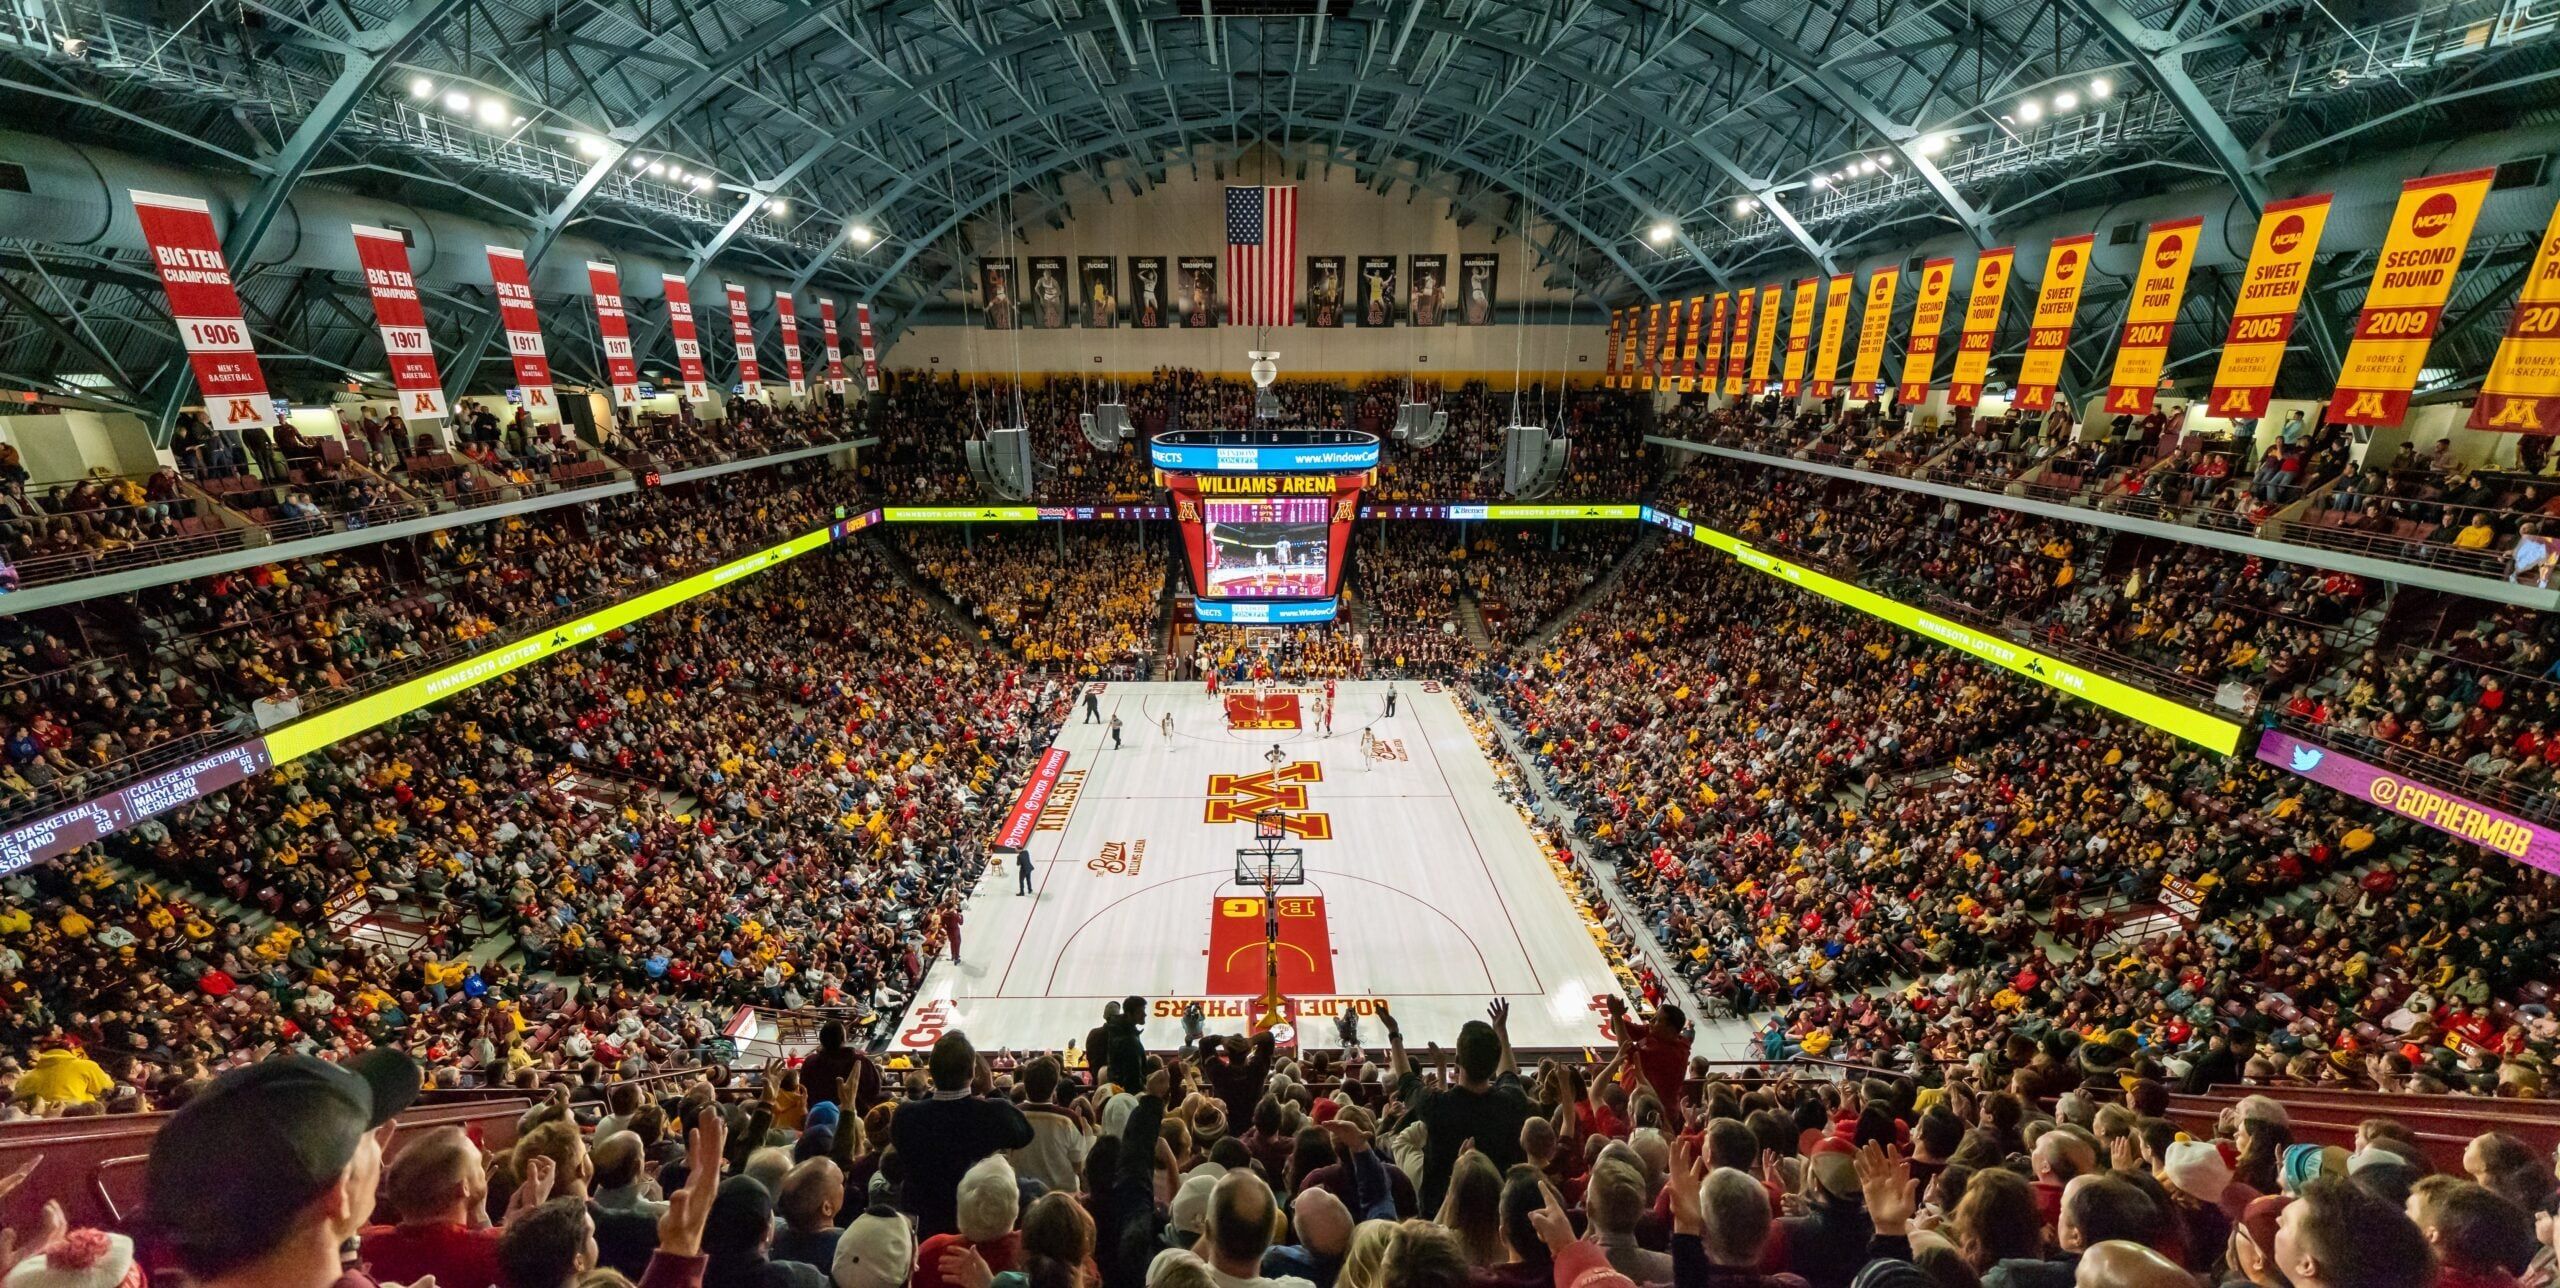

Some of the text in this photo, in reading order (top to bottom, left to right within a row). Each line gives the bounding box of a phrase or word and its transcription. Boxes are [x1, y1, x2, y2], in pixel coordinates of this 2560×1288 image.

[2414, 213, 2456, 228] NCAA
[2272, 233, 2303, 246] NCAA
[156, 246, 224, 269] BIG TEN
[2385, 247, 2456, 268] SECOND
[163, 268, 230, 285] CHAMPIONS
[368, 268, 412, 288] BIG TEN
[2255, 262, 2301, 281] SWEET
[2382, 269, 2445, 288] ROUND
[372, 287, 417, 300] CHAMPIONS
[497, 282, 530, 298] BIG TEN
[2045, 287, 2075, 300] SWEET
[2145, 277, 2175, 292] FINAL
[2245, 280, 2300, 300] SIXTEEN
[500, 298, 533, 309] CHAMPIONS
[596, 294, 622, 307] BIG TEN
[1919, 301, 1943, 312] SECOND
[1973, 294, 2000, 307] SECOND
[2039, 301, 2074, 314] SIXTEEN
[2142, 294, 2171, 307] FOUR
[1918, 313, 1939, 324] ROUND
[1972, 308, 1995, 320] ROUND
[2366, 311, 2428, 334] 2009
[191, 324, 240, 345] 1906
[2128, 326, 2164, 343] 2004
[2236, 318, 2283, 339] 2005
[391, 332, 422, 348] 1907
[513, 335, 537, 350] 1911
[608, 341, 626, 353] 1917
[1914, 338, 1934, 351] 1994
[1965, 334, 1990, 348] 2002
[2034, 331, 2063, 346] 2003
[2366, 354, 2406, 363] WOMEN'S
[208, 372, 253, 382] BASKETBALL
[218, 364, 240, 372] MEN'S
[2227, 365, 2267, 373] BASKETBALL
[2355, 364, 2407, 373] BASKETBALL
[415, 393, 437, 413] M
[530, 389, 548, 406] M
[2023, 386, 2044, 405] M
[2115, 389, 2141, 408] M
[2221, 389, 2253, 412] M
[228, 400, 262, 423] M
[2345, 392, 2385, 418] M
[2489, 399, 2542, 428] M
[1197, 477, 1336, 493] WILLIAMS ARENA
[1178, 501, 1200, 522] M
[1333, 501, 1354, 522] M
[1918, 618, 1969, 644] MINNESOTA
[1972, 638, 2016, 662] LOTTERY
[426, 659, 496, 696] MINNESOTA
[499, 641, 542, 667] LOTTERY
[1050, 751, 1063, 770] TOYOTA
[130, 746, 249, 798] COLLEGE BASKETBALL
[133, 753, 265, 807] MARYLAND 60 F
[138, 764, 255, 818] NEBRASKA 45
[1031, 780, 1049, 805] TOYOTA
[15, 802, 102, 845] BASKETBALL
[1012, 813, 1032, 837] TOYOTA
[2370, 776, 2534, 858] @GOPHERMBB
[4, 809, 122, 861] ISLAND 53 F
[97, 821, 114, 833] 68
[1087, 841, 1126, 873] Barn
